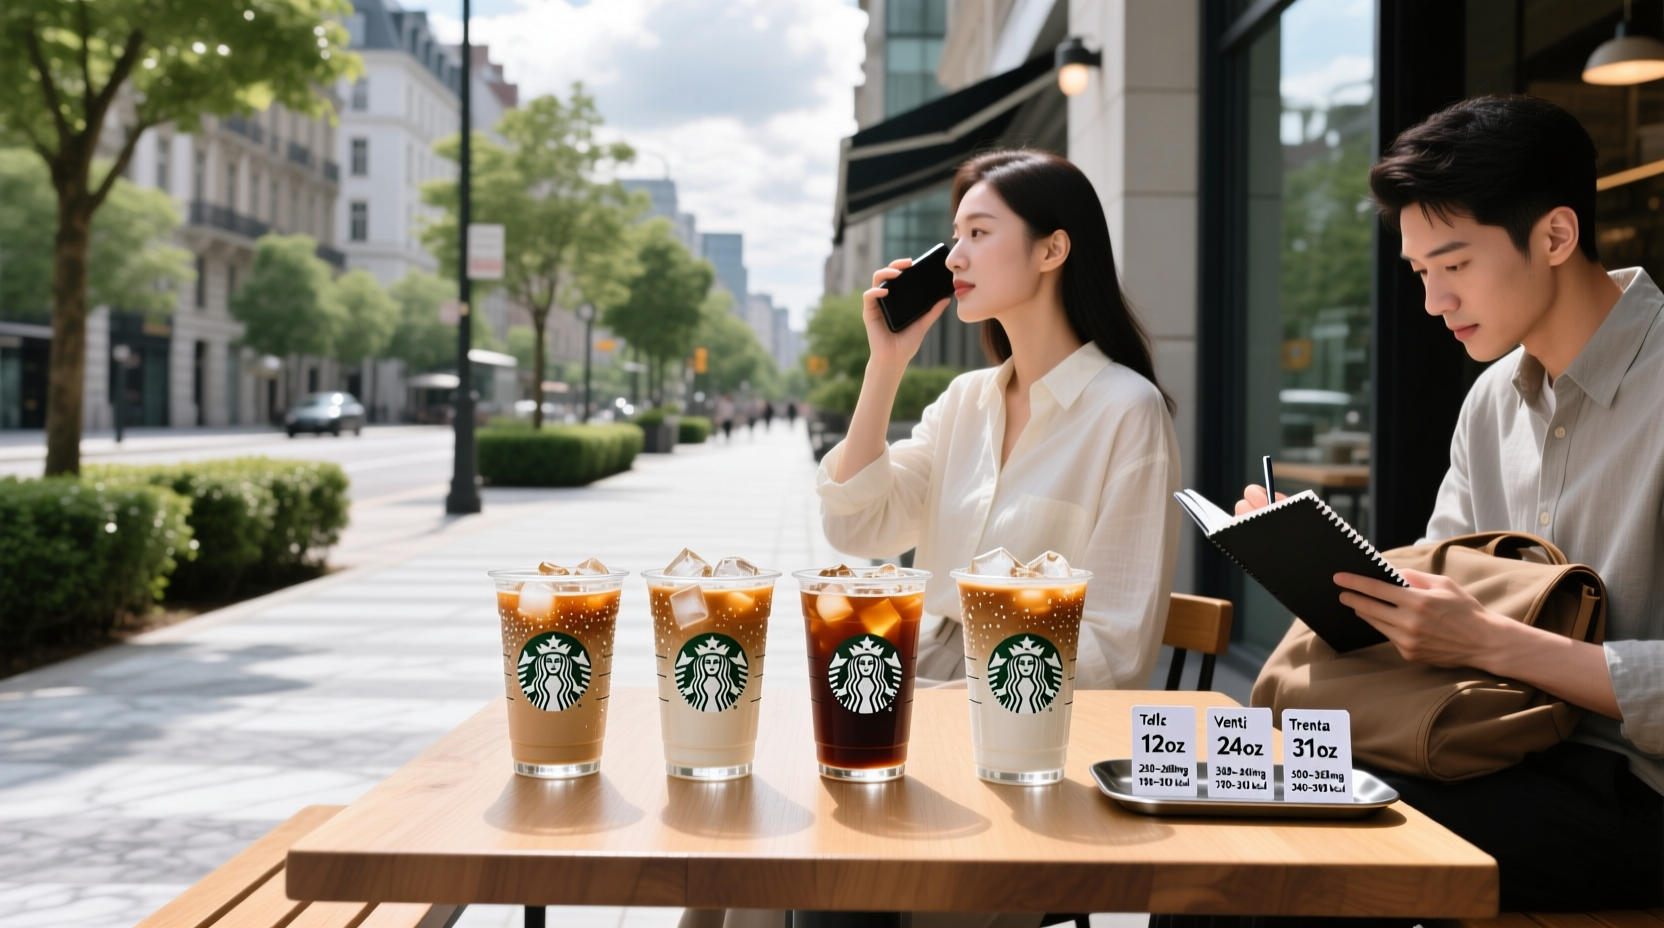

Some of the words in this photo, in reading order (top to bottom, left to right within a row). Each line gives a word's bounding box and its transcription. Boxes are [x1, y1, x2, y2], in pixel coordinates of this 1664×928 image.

[1214, 715, 1247, 729] Venti
[1288, 718, 1330, 732] Trenta
[1141, 733, 1186, 753] 12oz
[1217, 735, 1264, 756] 24oz
[1292, 737, 1338, 758] 31oz
